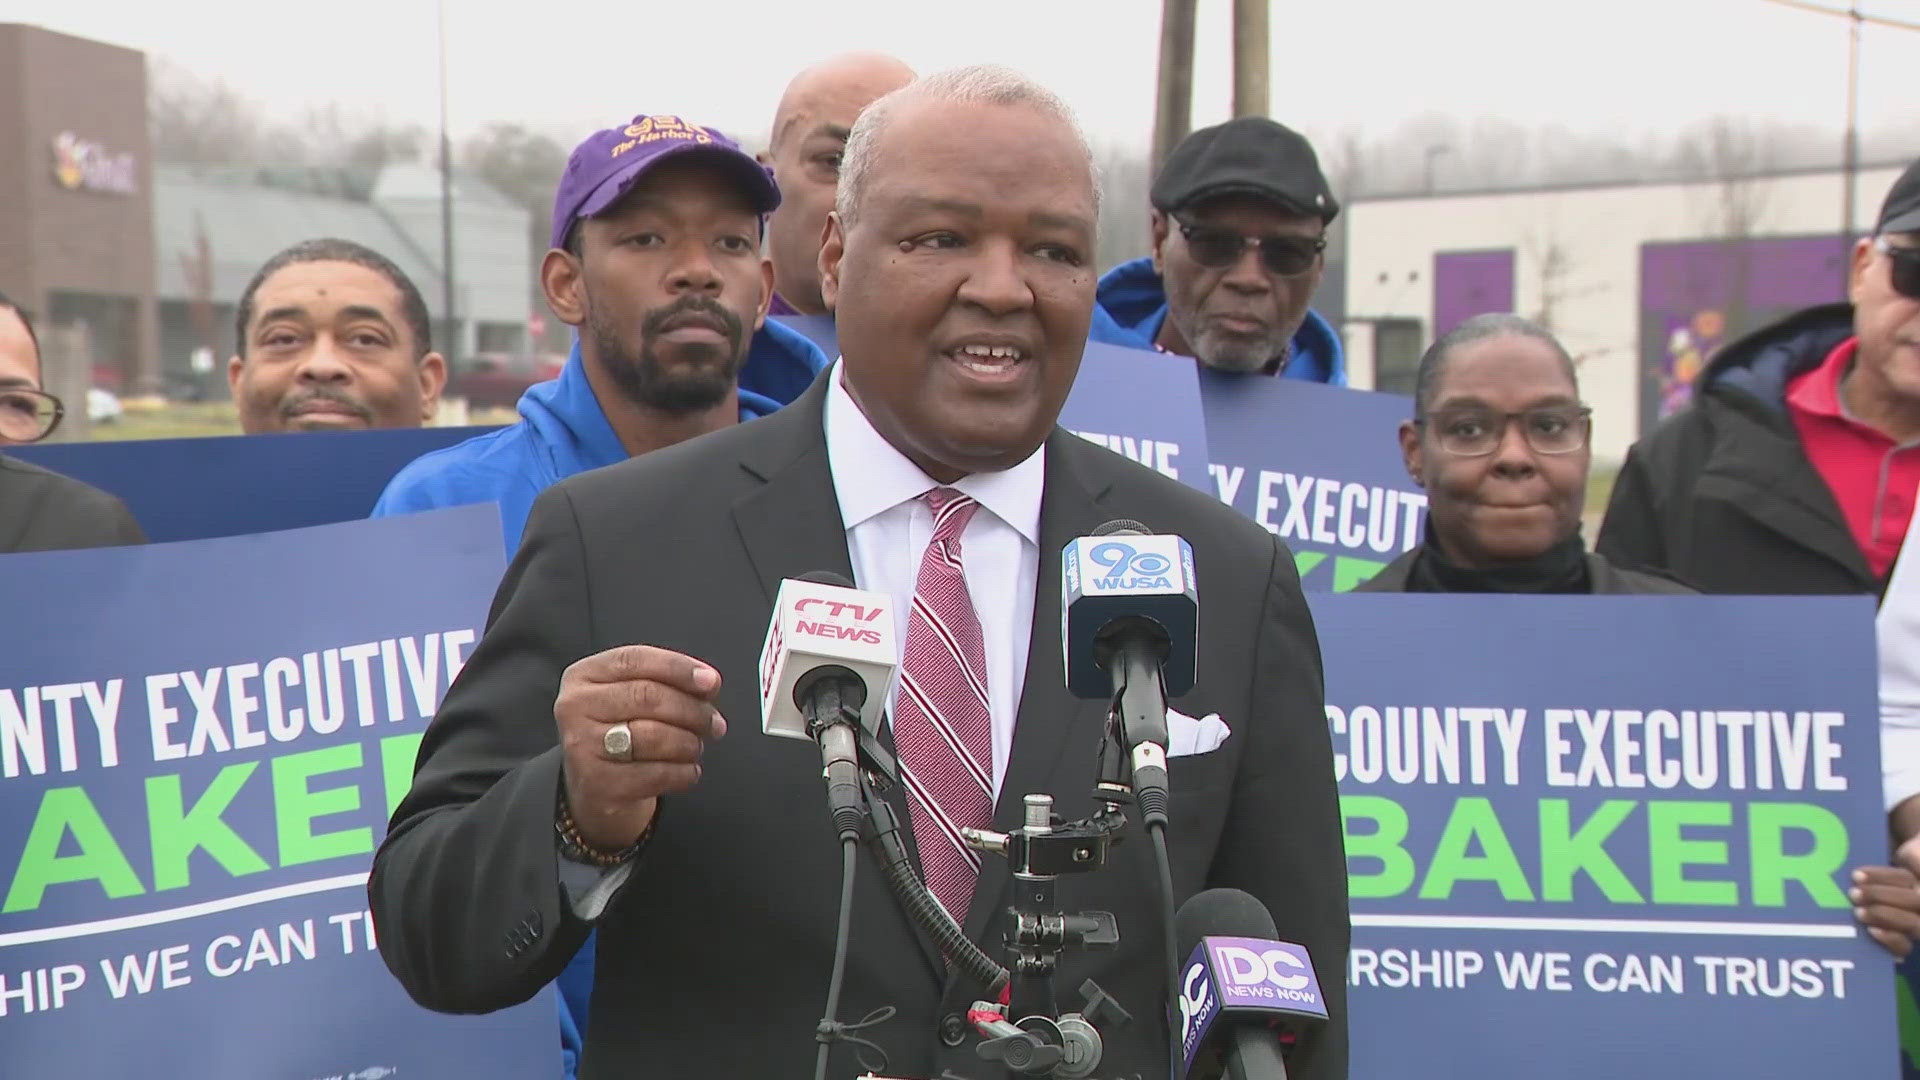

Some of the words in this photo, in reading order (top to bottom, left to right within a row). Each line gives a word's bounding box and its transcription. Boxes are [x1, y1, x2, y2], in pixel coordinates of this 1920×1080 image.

[611, 139, 636, 158] The
[638, 129, 695, 144] Harbor
[1255, 470, 1428, 553] EXECUT
[1090, 542, 1137, 577] 9
[1093, 577, 1173, 589] WUSA
[794, 598, 884, 621] CTV
[795, 620, 882, 644] NEWS
[0, 679, 123, 778] NTY
[1324, 705, 1527, 785] COUNTY
[1544, 709, 1849, 790] EXECUTIVE
[1338, 795, 1852, 909] BAKER
[0, 965, 86, 1017] HIP
[100, 944, 191, 999] WE
[205, 919, 316, 977] CAN
[1216, 946, 1310, 990] DC
[1494, 951, 1573, 991] WE
[1583, 953, 1684, 993] CAN
[1693, 956, 1855, 998] TRUST
[1226, 986, 1274, 998] NEWS
[1277, 989, 1315, 1004] NOW
[1183, 1027, 1197, 1061] EWS
[1195, 993, 1214, 1030] NOW
